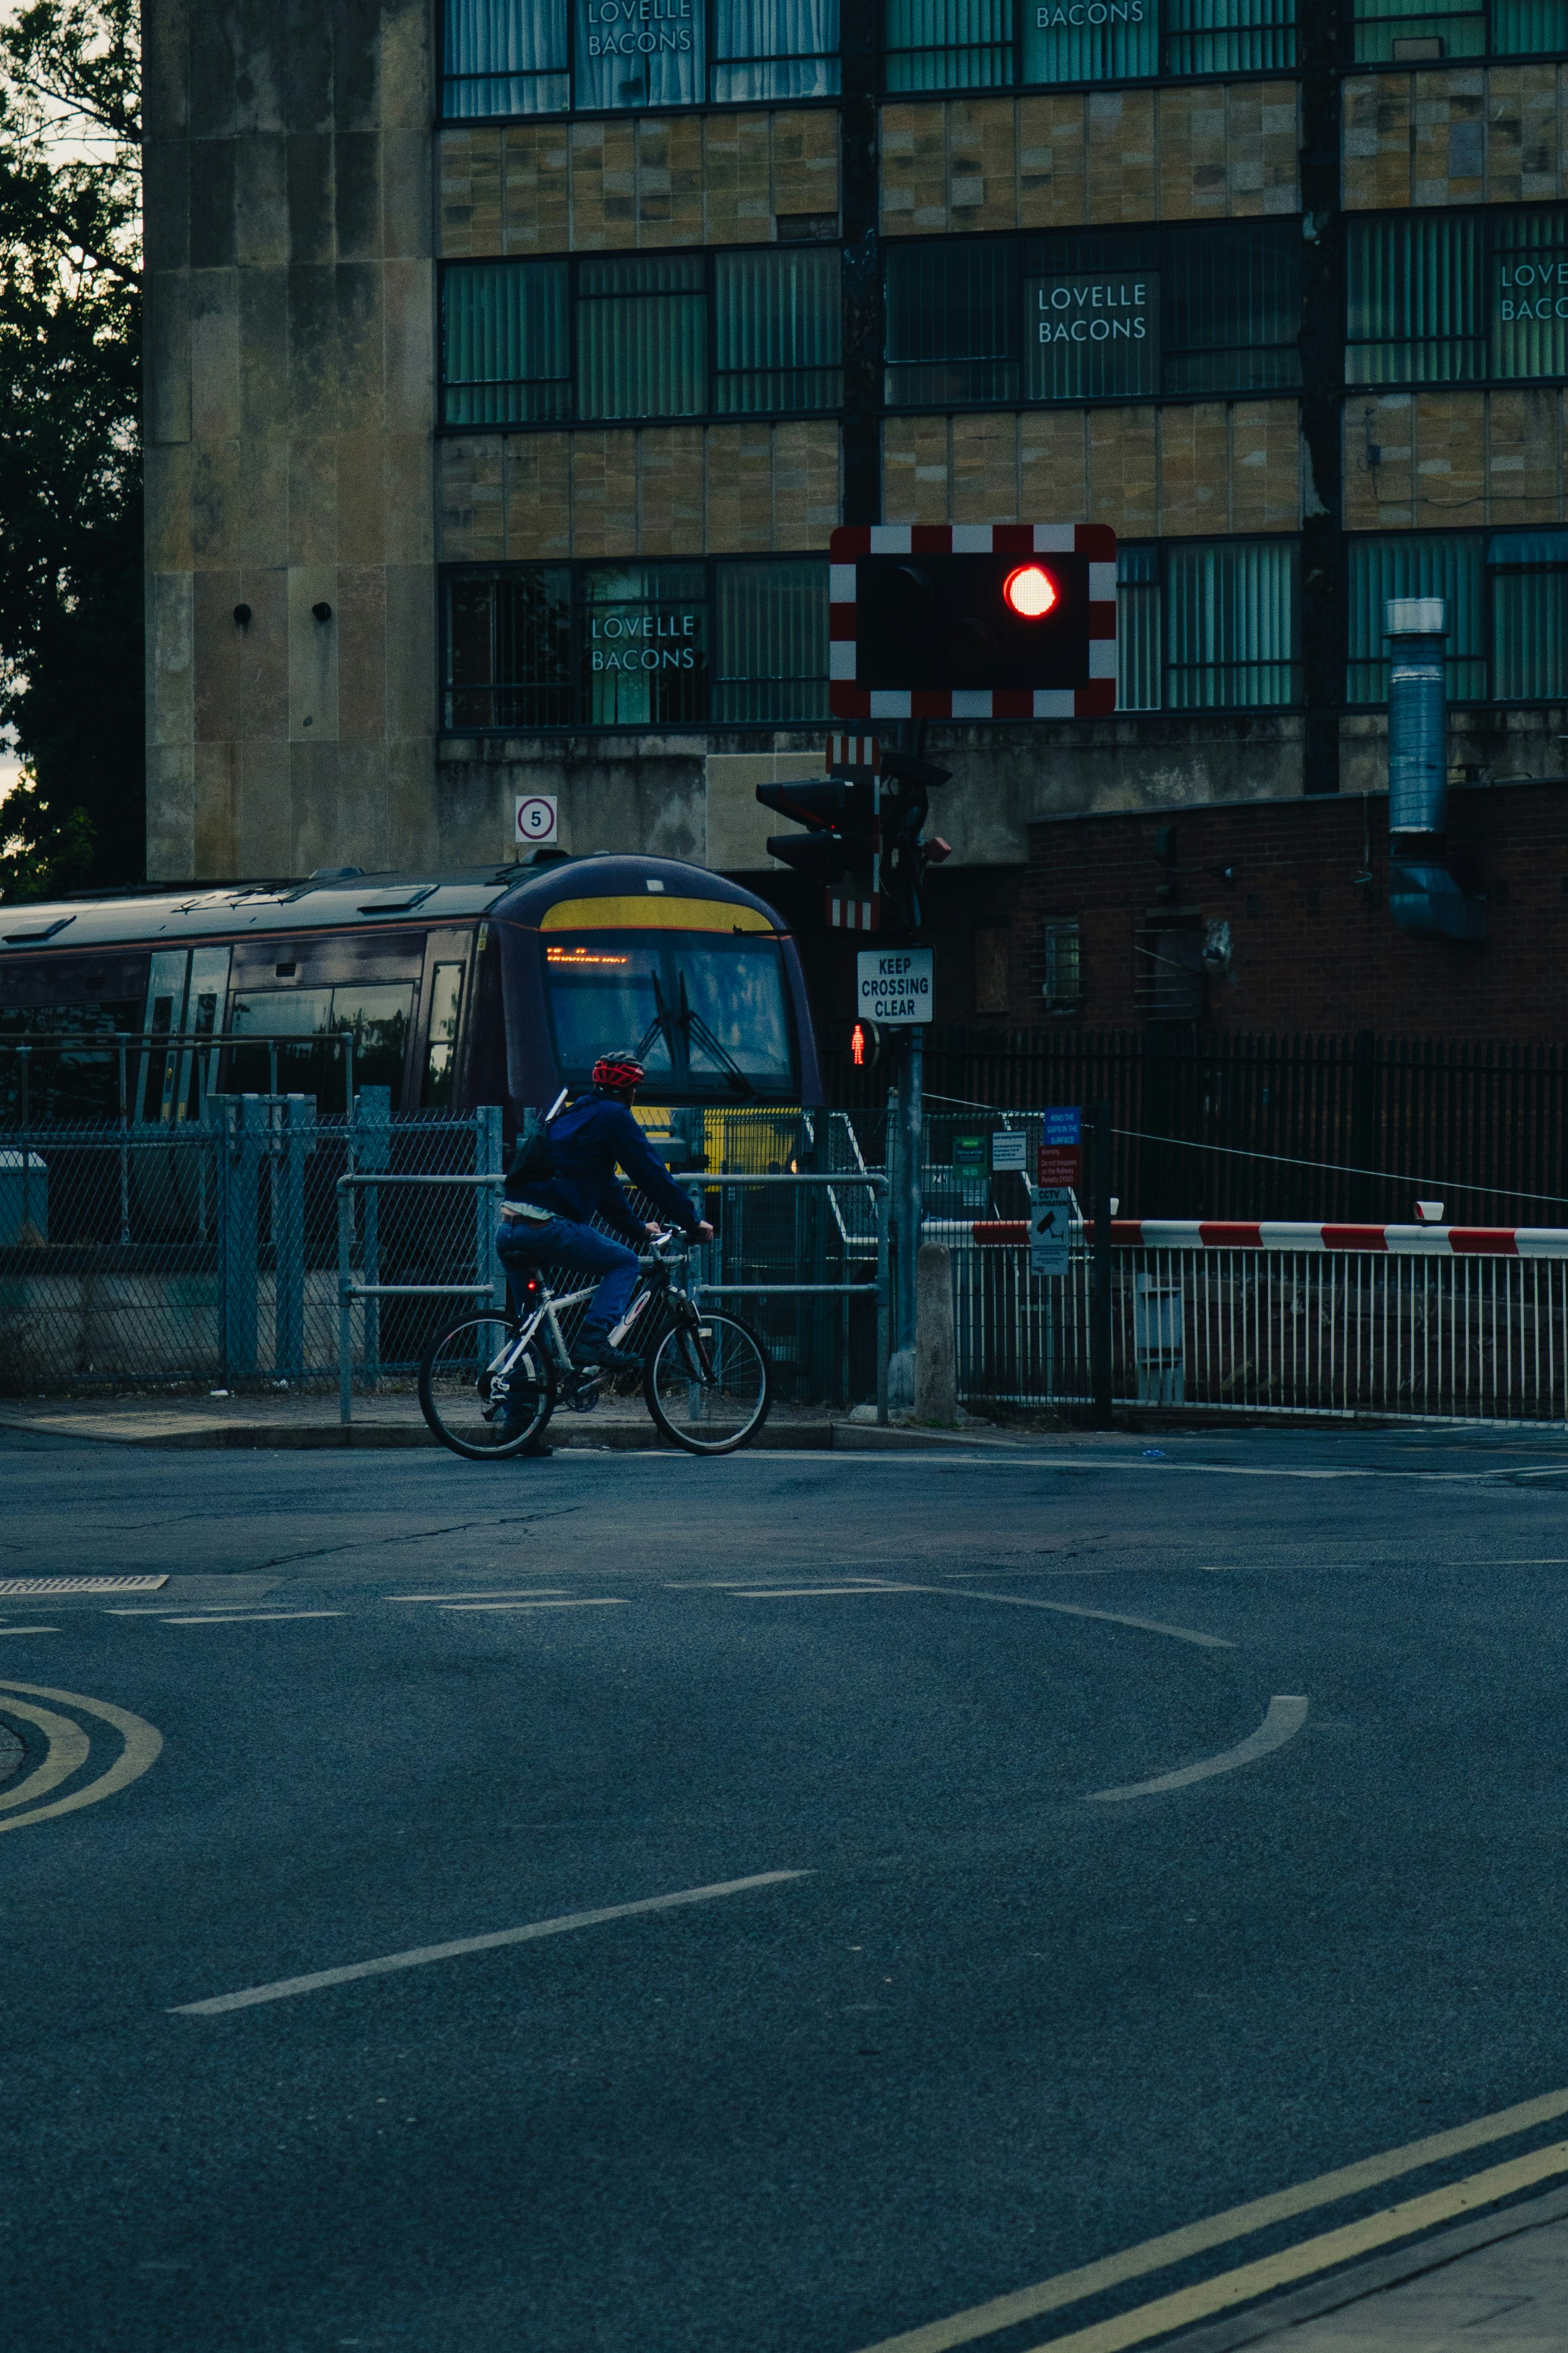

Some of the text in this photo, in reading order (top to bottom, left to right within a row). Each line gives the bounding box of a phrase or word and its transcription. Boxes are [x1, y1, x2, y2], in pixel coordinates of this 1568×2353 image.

[589, 0, 691, 23] LOVELLE
[1037, 1, 1144, 28] BACONS
[589, 30, 691, 56] BACONS
[1501, 263, 1568, 287] LOVE
[1039, 283, 1146, 310] LOVELLE
[1039, 317, 1146, 343] BACONS
[592, 615, 694, 639] LOVELLE
[592, 648, 694, 671] BACONS
[531, 811, 541, 827] 5
[880, 957, 911, 975] KEEP
[862, 977, 928, 997] CROSSING
[875, 999, 915, 1017] CLEAR
[1062, 1125, 1068, 1133] IN
[1068, 1124, 1078, 1132] THE
[1050, 1136, 1074, 1145] SURFACE
[1039, 1190, 1060, 1200] CCTV
